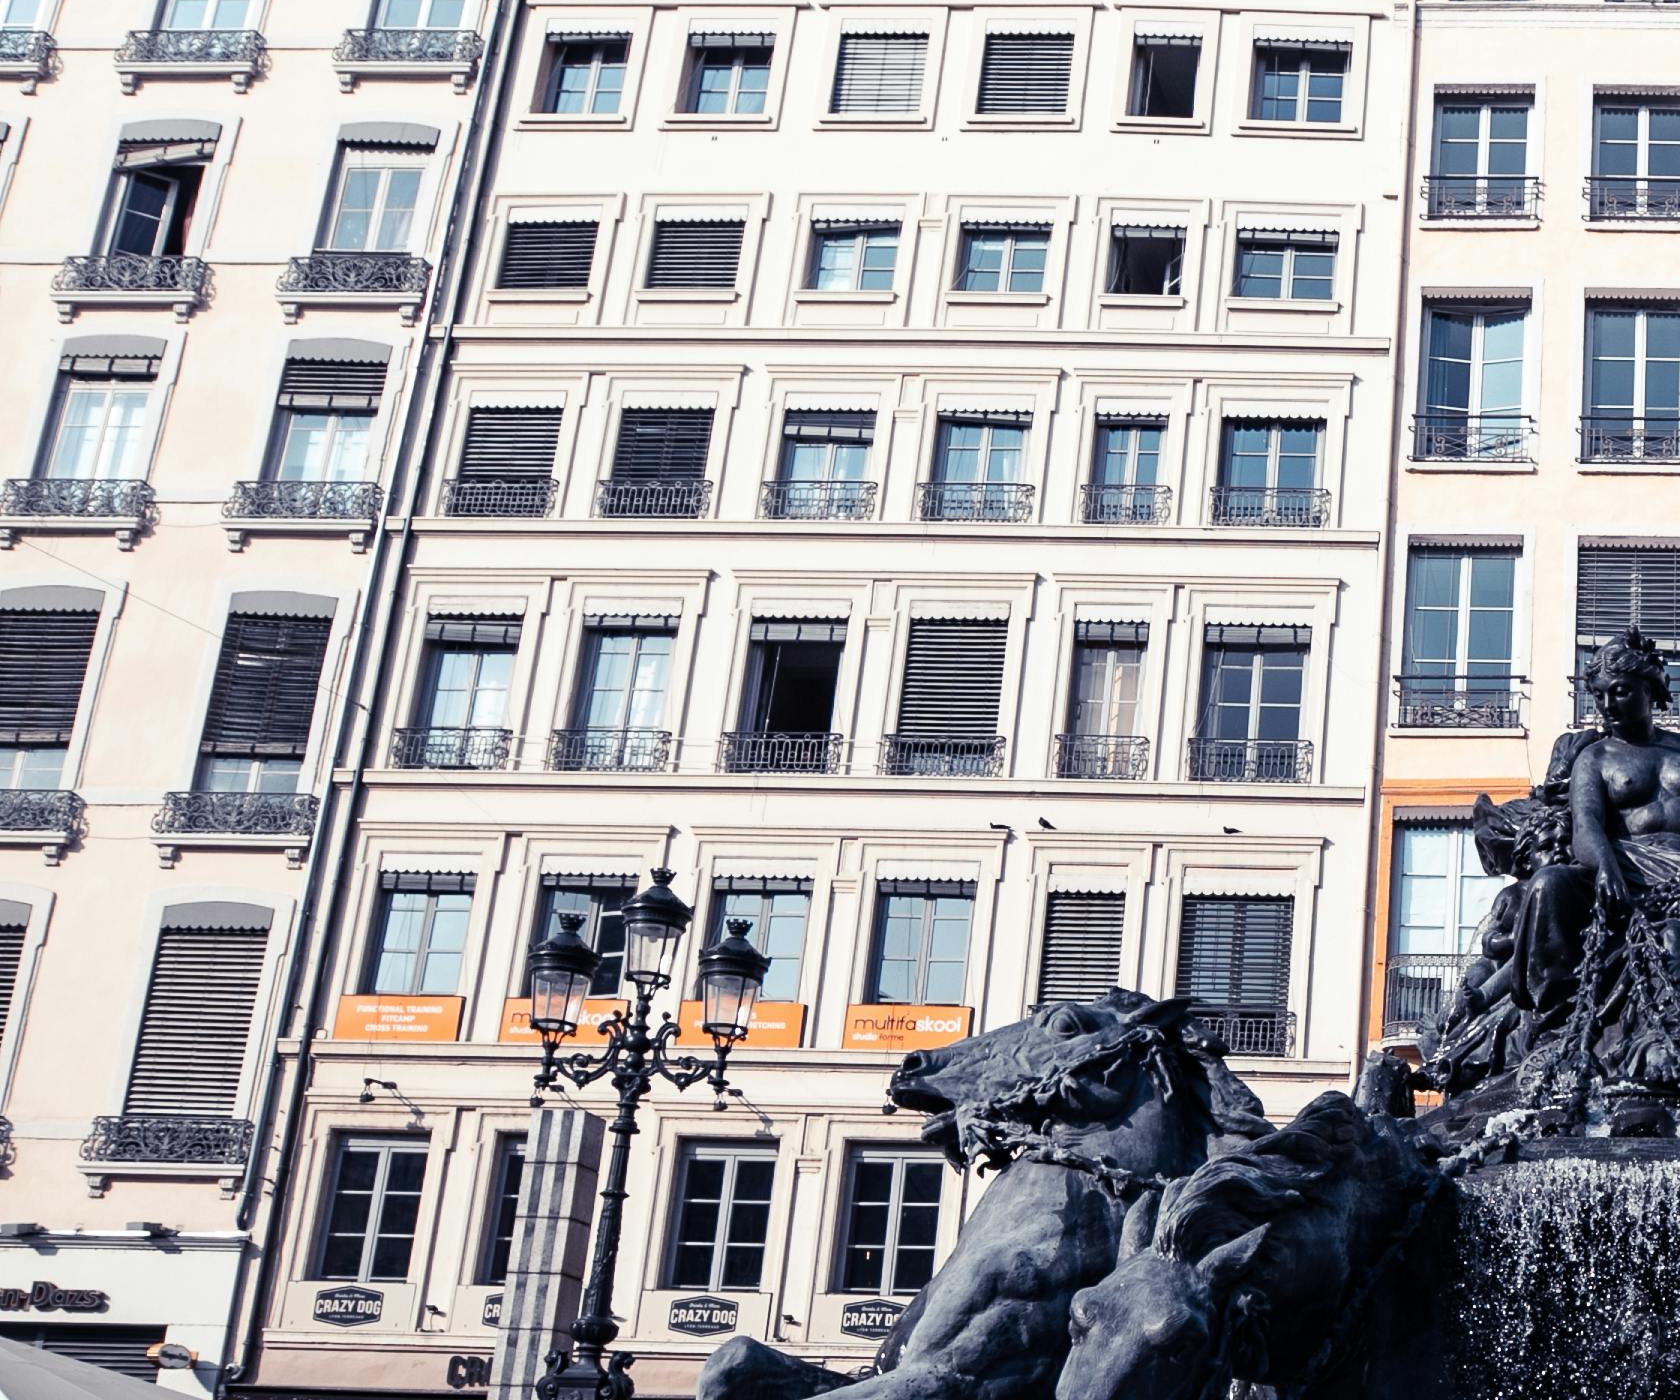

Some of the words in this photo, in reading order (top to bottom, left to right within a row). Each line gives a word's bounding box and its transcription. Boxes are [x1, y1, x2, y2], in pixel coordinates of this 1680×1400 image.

[0, 1281, 102, 1310] n-Dazs
[315, 1300, 356, 1314] CRAZY
[357, 1301, 381, 1315] DOG
[670, 1309, 710, 1324] CRAZY
[712, 1310, 736, 1325] DOG
[843, 1312, 887, 1327] CRAZY
